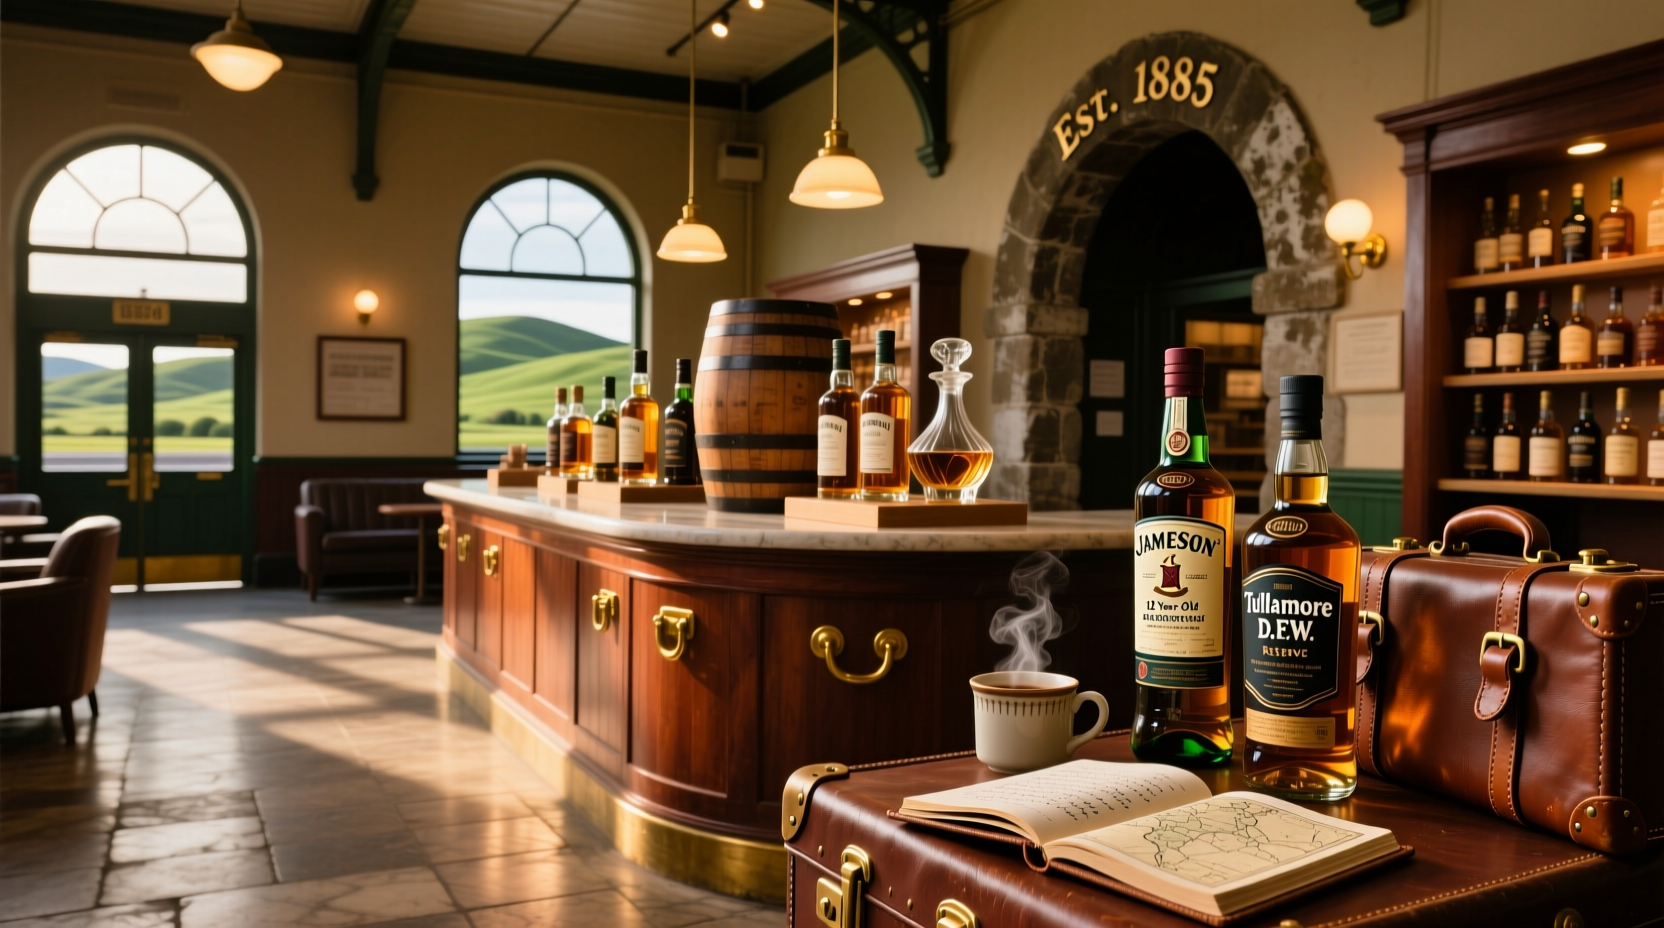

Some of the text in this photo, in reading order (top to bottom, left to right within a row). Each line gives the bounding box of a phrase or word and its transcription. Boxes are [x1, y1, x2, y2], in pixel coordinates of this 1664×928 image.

[1052, 55, 1218, 161] Est. 1885
[1146, 600, 1156, 611] 12
[1181, 600, 1199, 612] Old
[1244, 591, 1333, 618] Tullamore
[1257, 617, 1314, 642] D.E.W.
